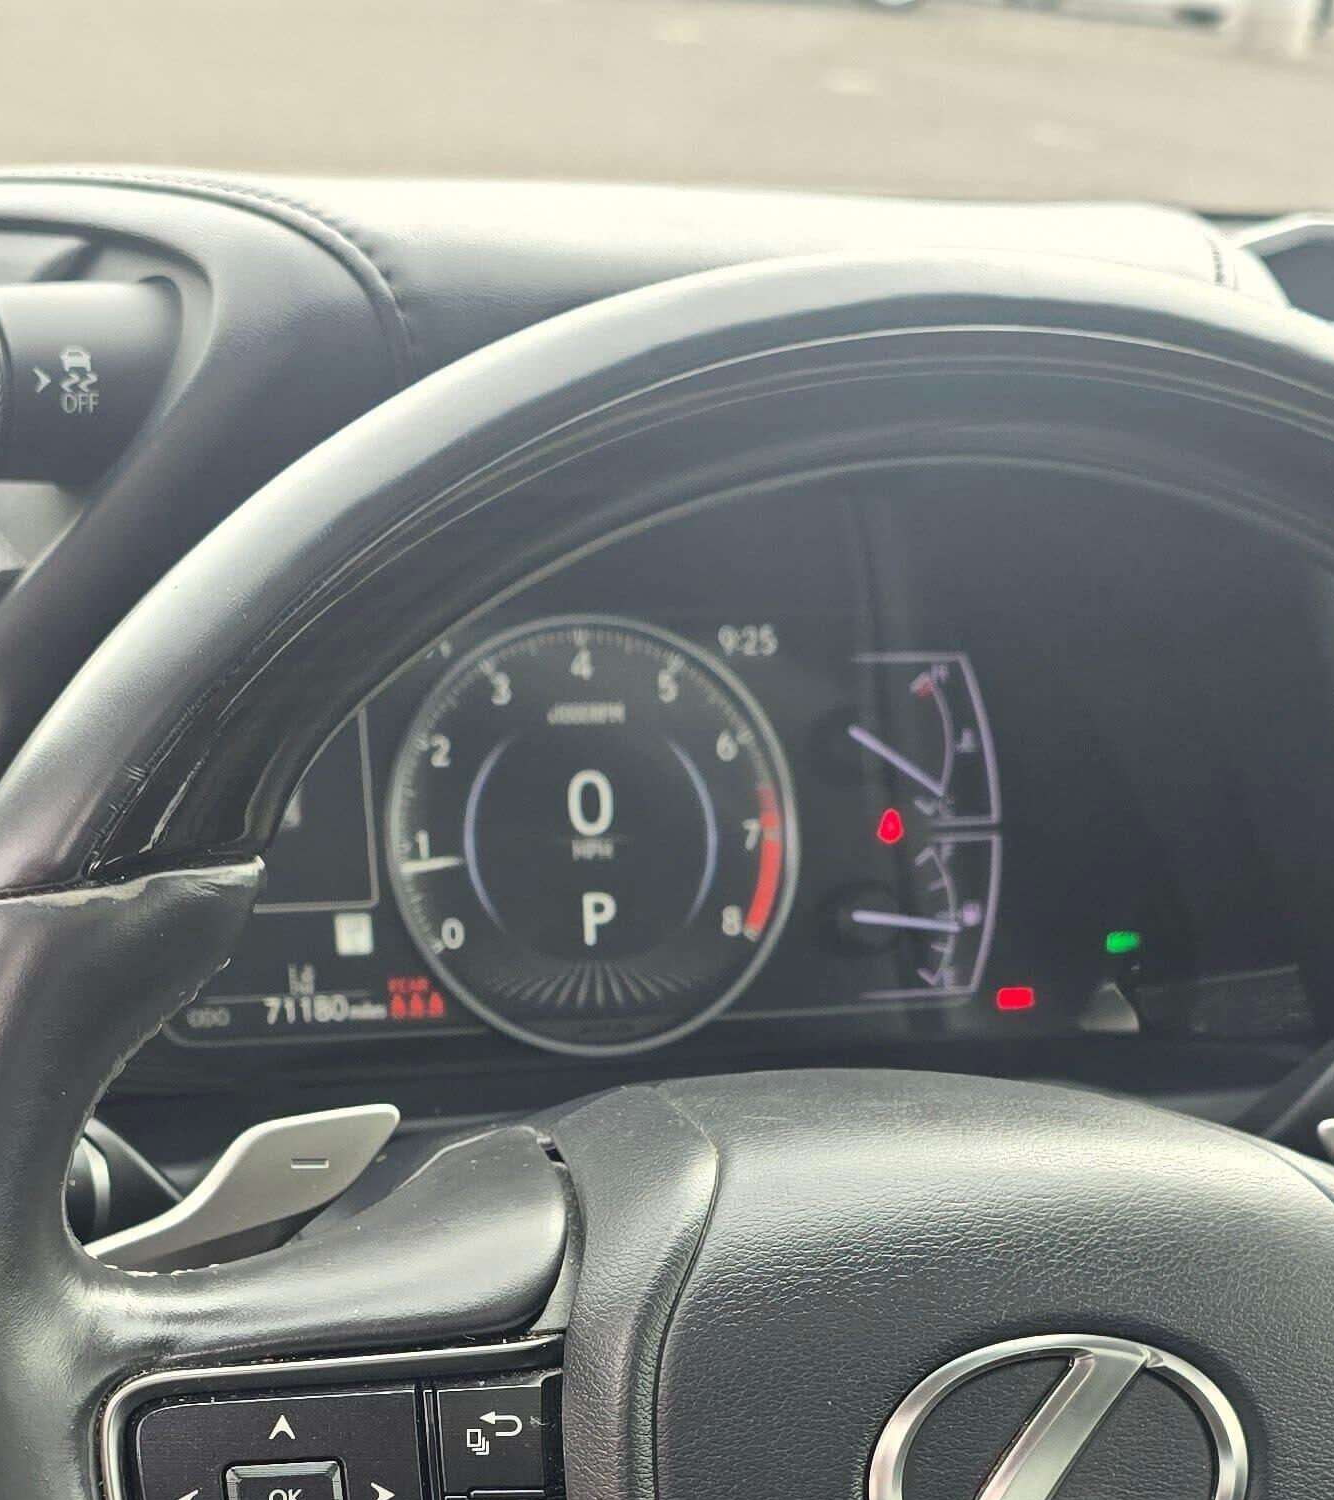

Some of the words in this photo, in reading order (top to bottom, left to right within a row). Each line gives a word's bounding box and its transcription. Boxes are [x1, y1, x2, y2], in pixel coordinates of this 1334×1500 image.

[61, 391, 101, 416] OFF
[717, 624, 779, 658] 9:25
[571, 649, 595, 682] 4
[491, 671, 513, 706] 3
[657, 668, 679, 703] 5
[430, 734, 451, 768] 2
[716, 730, 740, 762] 6
[567, 768, 614, 837] 0
[415, 830, 431, 860] 1
[742, 818, 761, 851] 7
[440, 917, 466, 950] 0
[581, 891, 618, 947] P
[721, 904, 744, 938] 8
